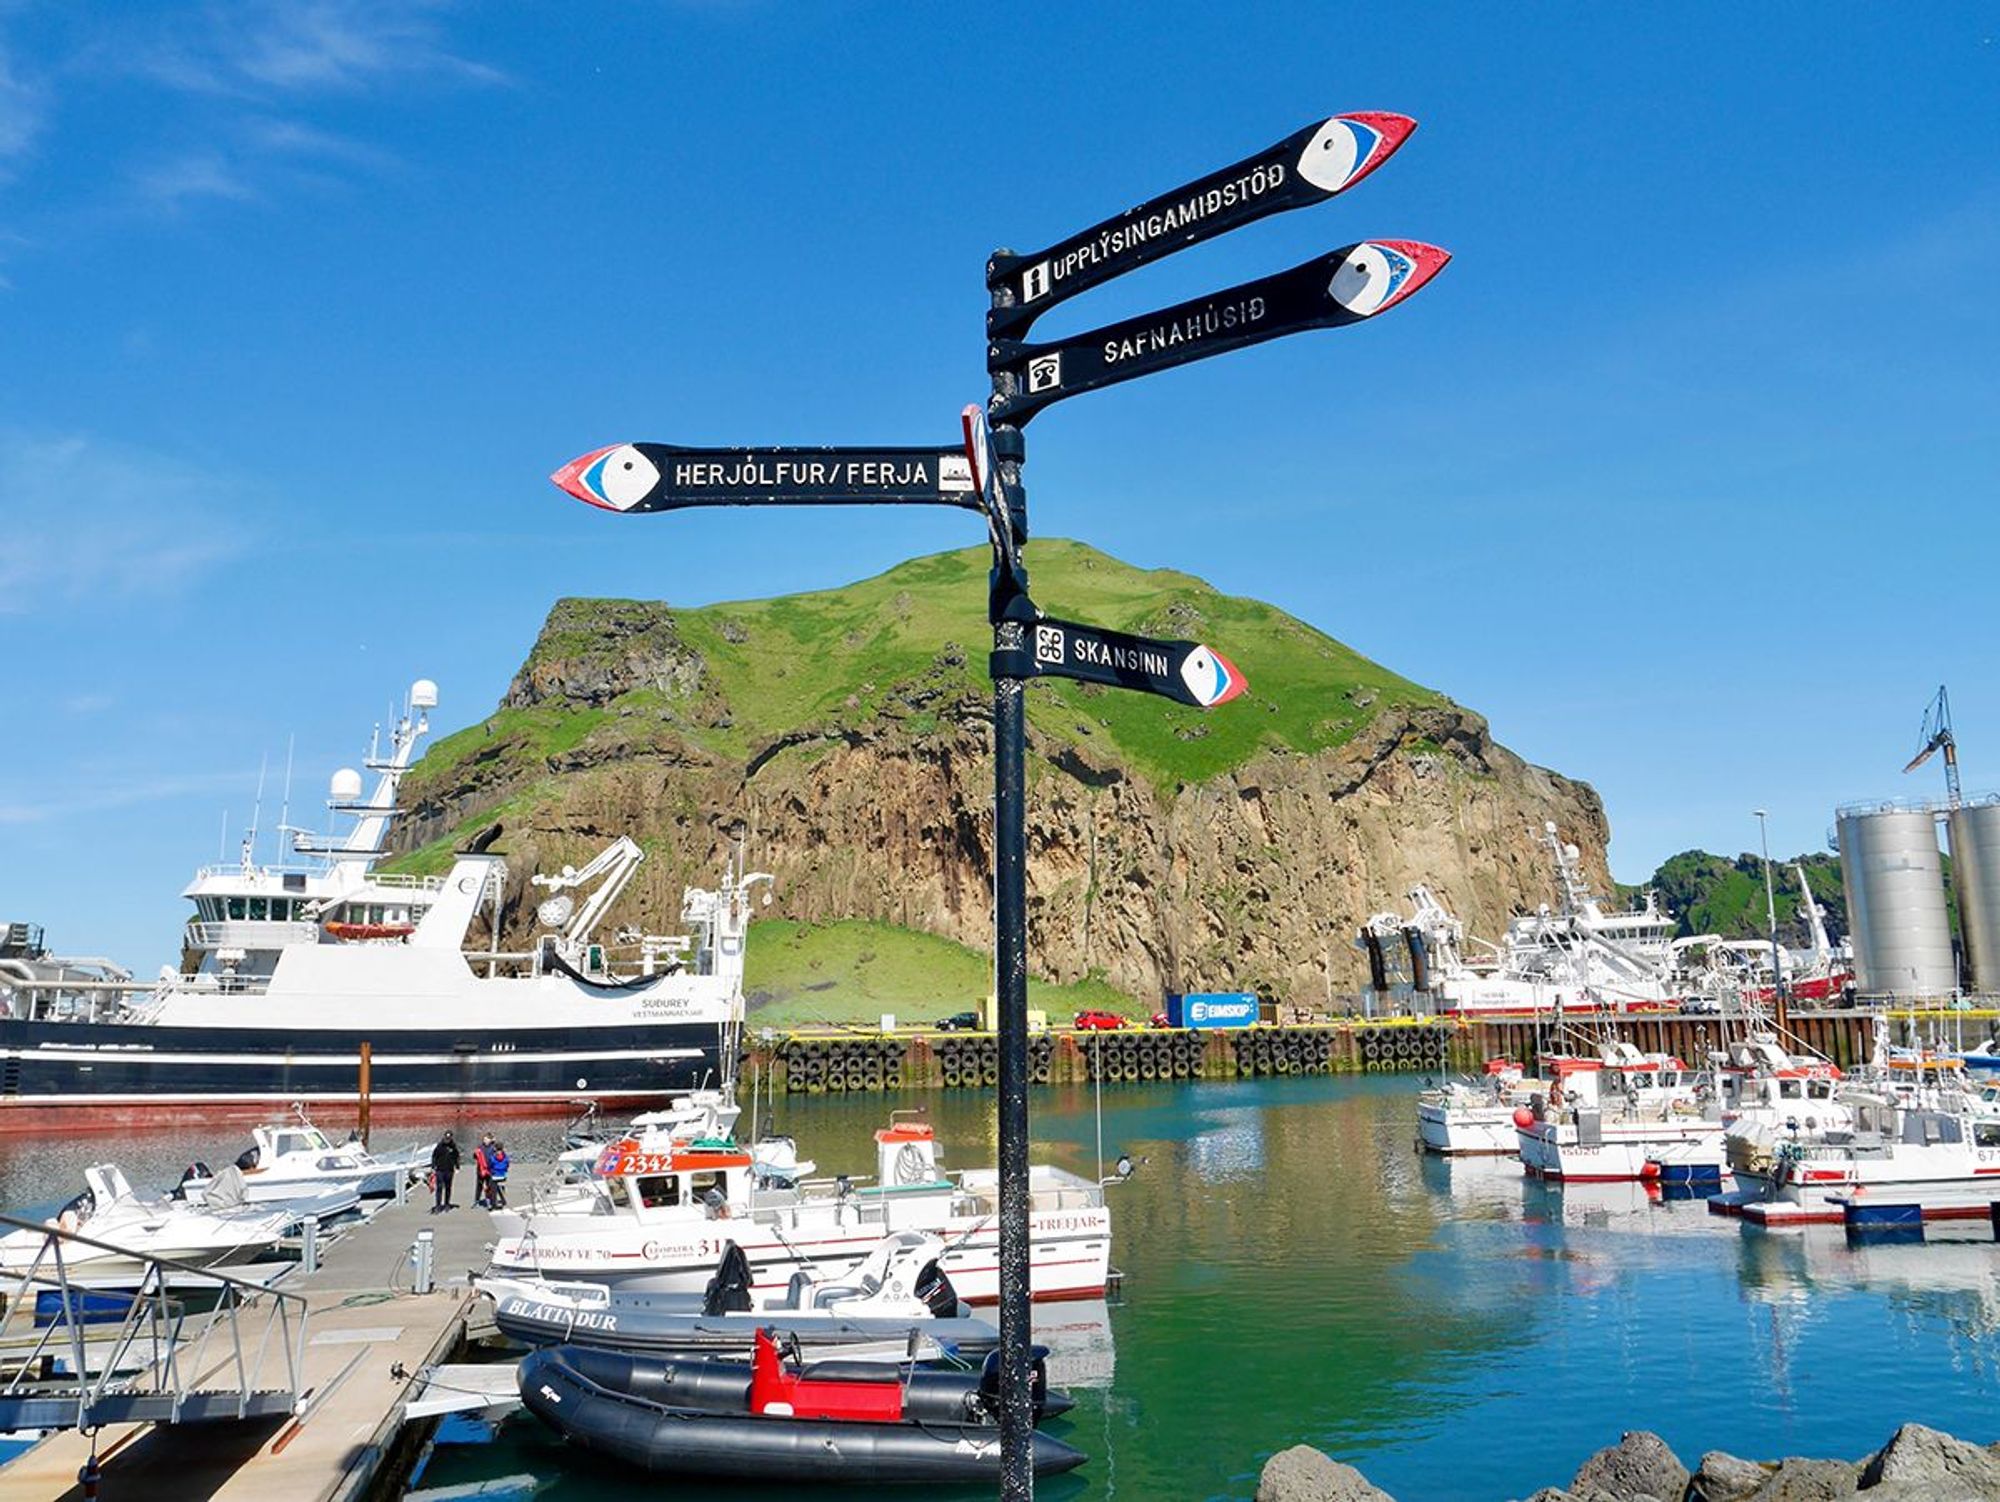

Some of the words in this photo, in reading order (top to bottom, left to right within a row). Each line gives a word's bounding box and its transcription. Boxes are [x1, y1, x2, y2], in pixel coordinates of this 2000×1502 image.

[1053, 162, 1286, 281] UPPLÝSINGAMIÐSTÖÐ
[1104, 296, 1266, 364] SAFNAHÚSIÐ
[1074, 639, 1169, 676] SKANSINN
[623, 1154, 673, 1173] 2342
[1038, 1215, 1098, 1231] TREFJAR
[697, 1237, 721, 1258] 31
